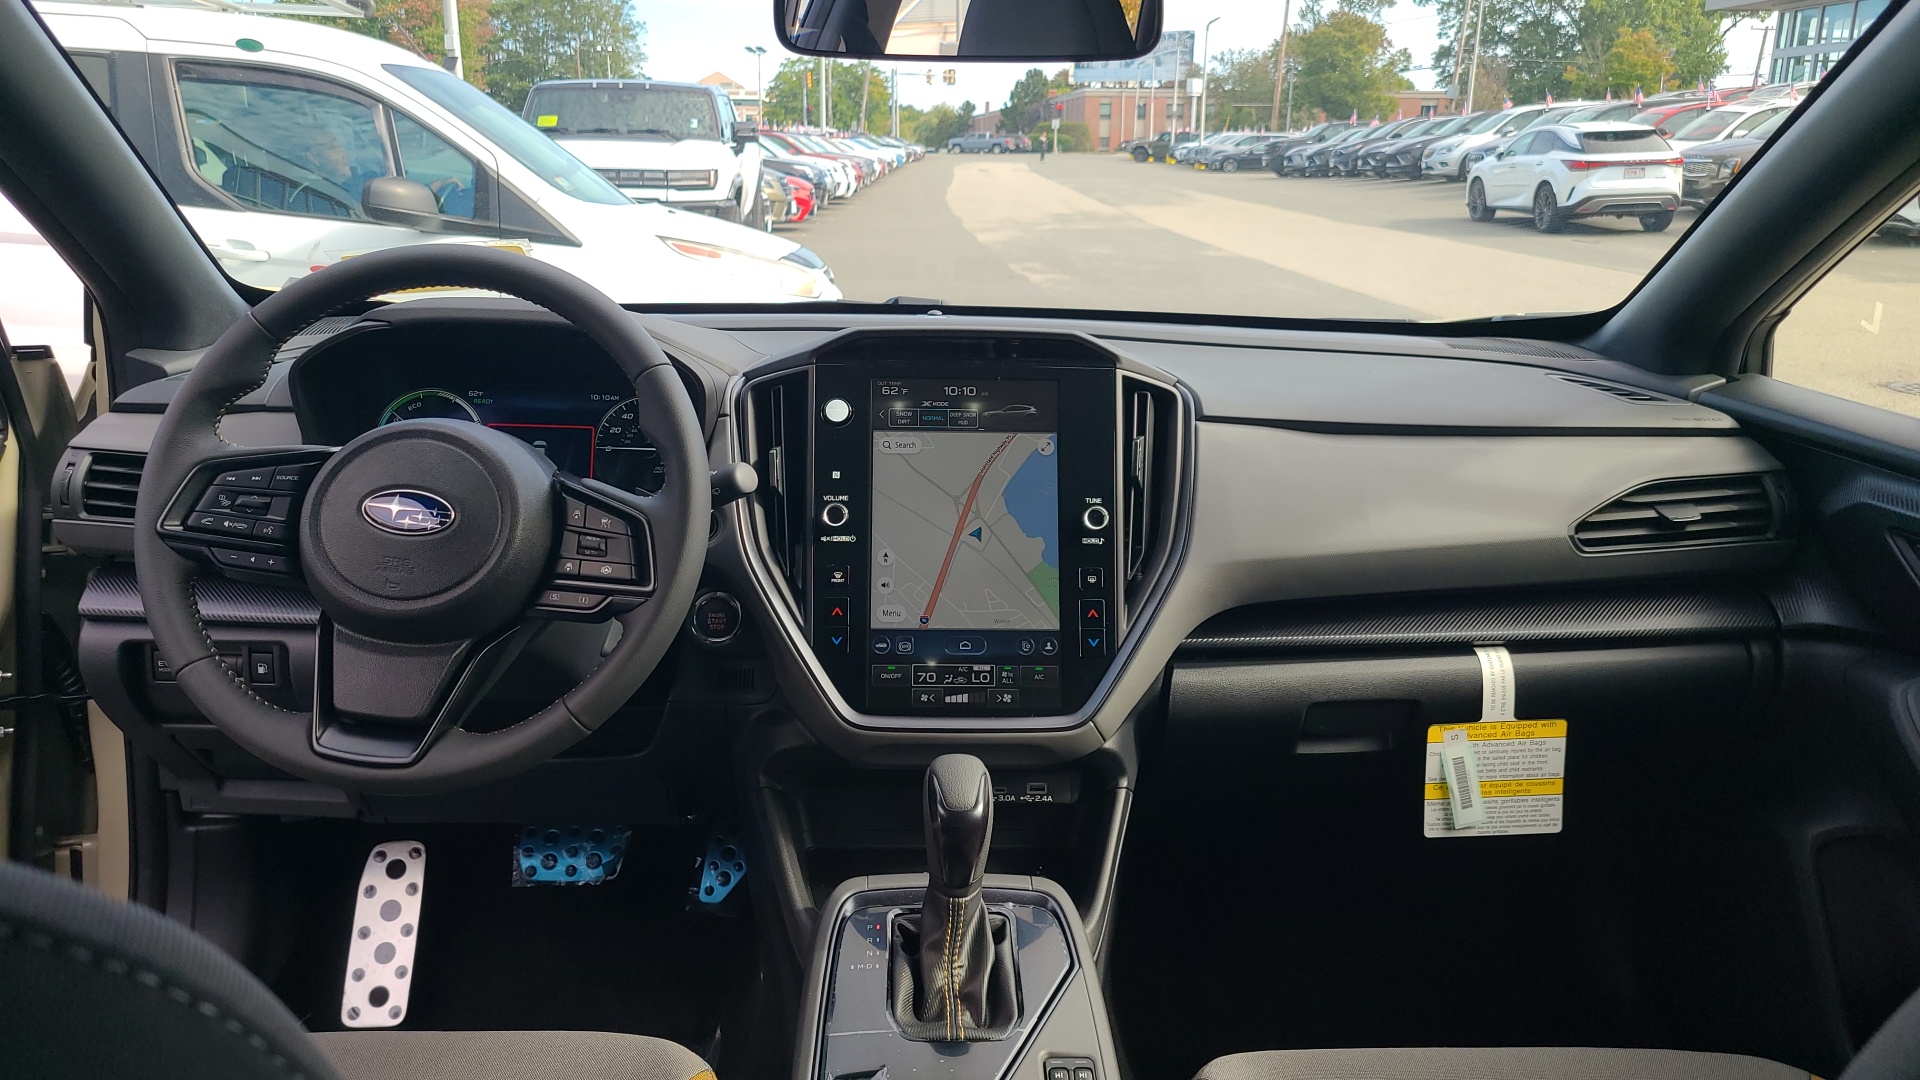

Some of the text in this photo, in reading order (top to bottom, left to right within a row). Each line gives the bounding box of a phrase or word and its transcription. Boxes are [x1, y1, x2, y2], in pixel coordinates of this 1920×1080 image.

[882, 386, 898, 395] 62
[944, 386, 977, 396] 10:10
[407, 402, 422, 411] ECO
[917, 673, 936, 682] 70
[972, 673, 990, 683] LO
[1500, 722, 1538, 730] Equipped
[1515, 730, 1535, 738] Bags
